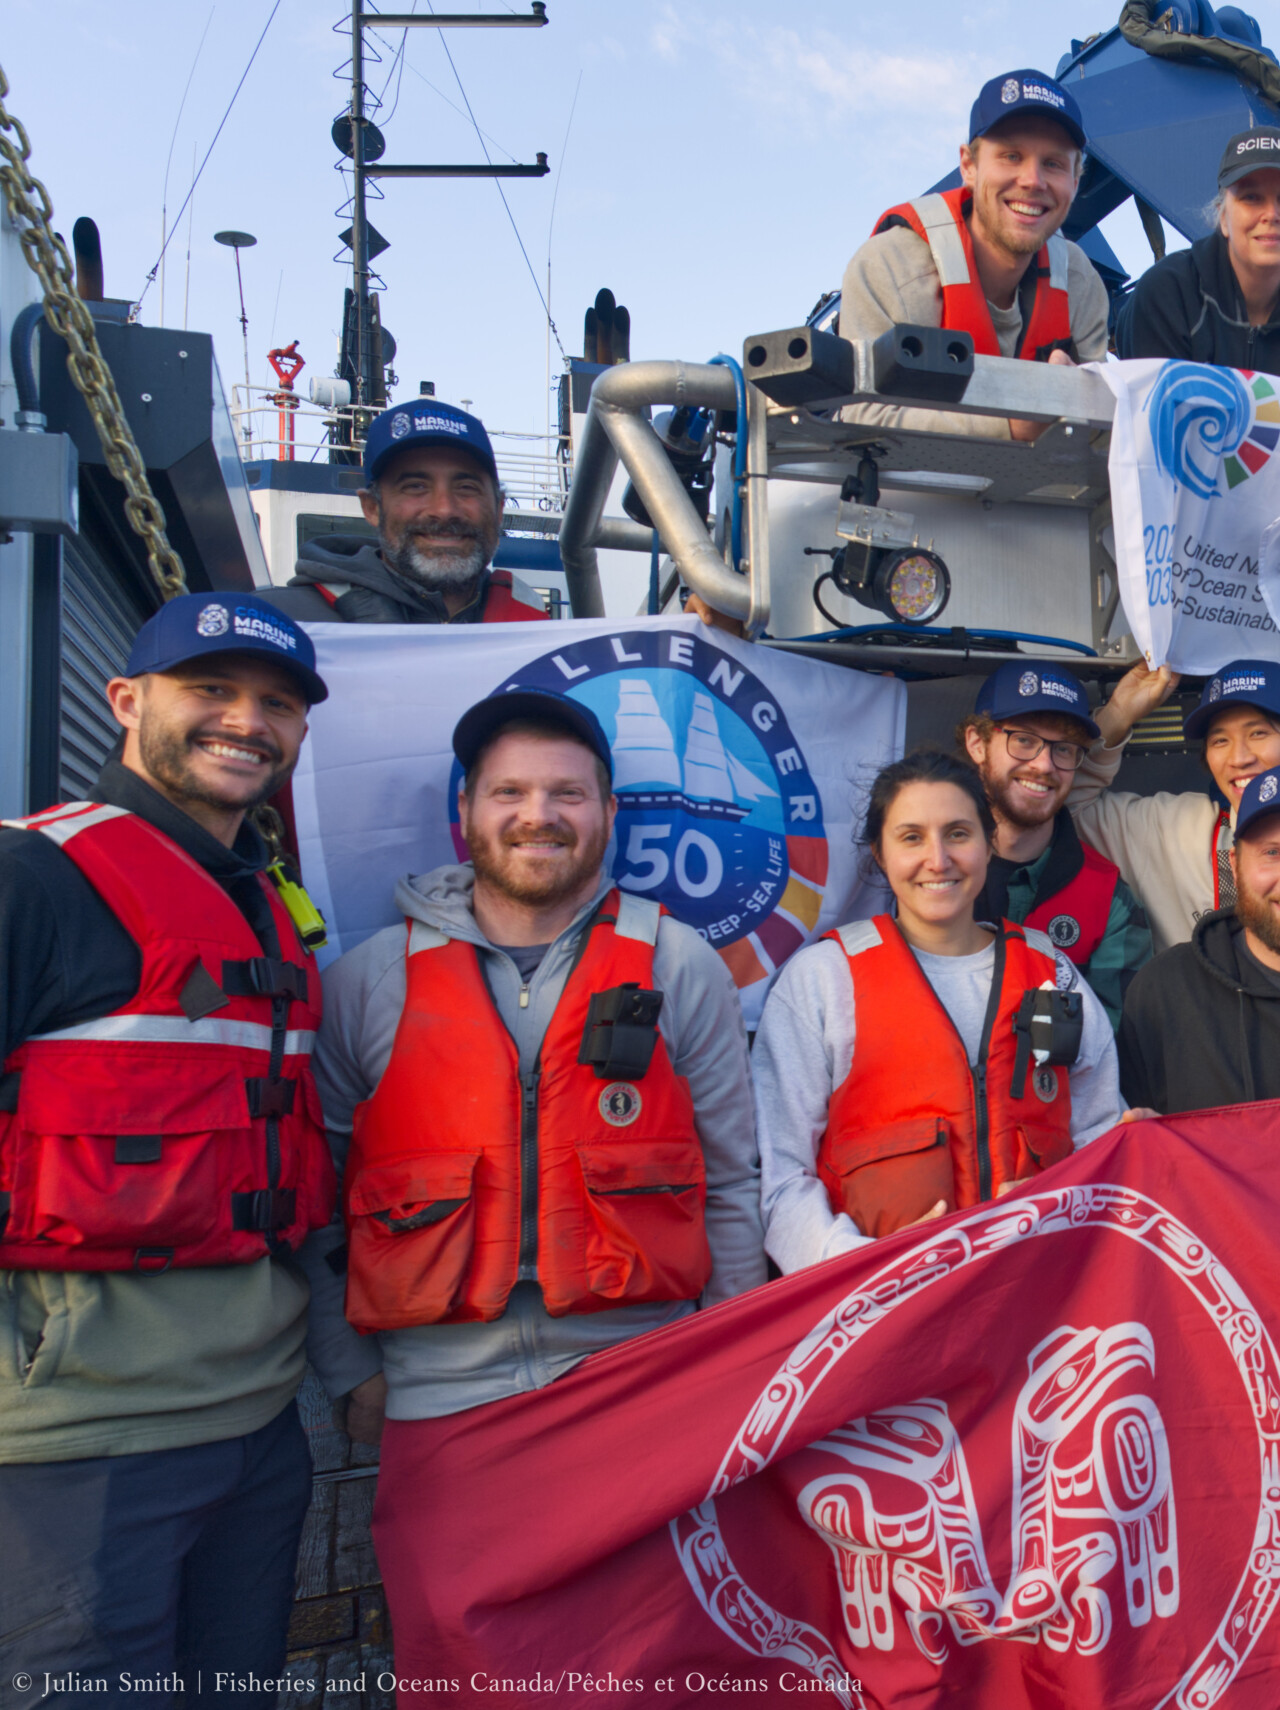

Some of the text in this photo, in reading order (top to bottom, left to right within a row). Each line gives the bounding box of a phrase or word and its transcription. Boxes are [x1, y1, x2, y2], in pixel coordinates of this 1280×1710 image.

[1023, 85, 1065, 107] MARINE
[414, 417, 468, 432] MARINE
[416, 426, 460, 435] SERVICES
[1183, 535, 1239, 569] United
[1172, 562, 1192, 583] of
[1189, 568, 1247, 599] Ocean
[234, 616, 297, 648] MARINE
[234, 627, 288, 650] SERVICES
[1041, 680, 1078, 702] MARINE
[1222, 677, 1266, 690] MARINE
[1222, 685, 1258, 695] SERVICES
[506, 635, 817, 822] LLENGER
[766, 837, 783, 877] LIFE
